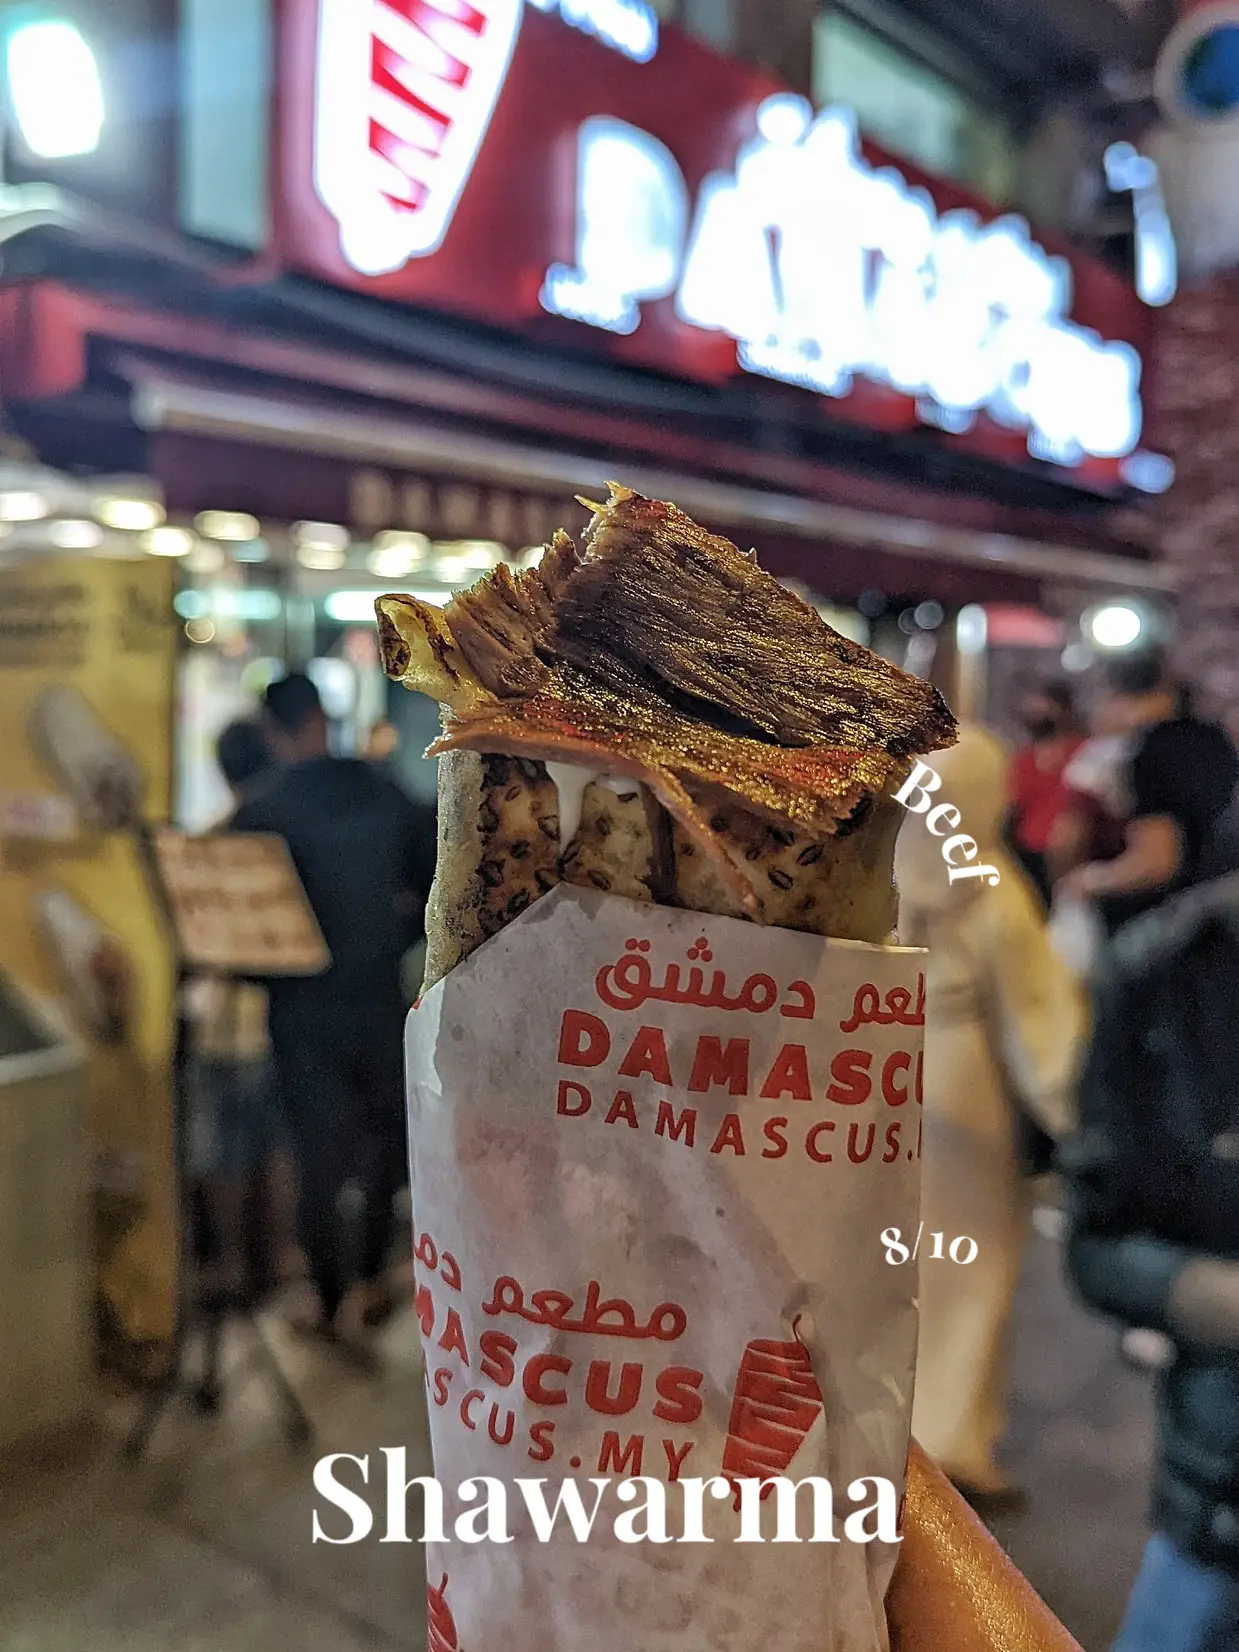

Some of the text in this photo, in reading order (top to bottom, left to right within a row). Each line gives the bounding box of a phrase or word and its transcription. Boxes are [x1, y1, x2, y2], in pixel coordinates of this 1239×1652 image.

[595, 936, 816, 1014] دمشق
[557, 1008, 924, 1107] DAMASC
[557, 1079, 922, 1166] DAMASCUS.
[482, 1275, 687, 1341] مطعم
[425, 1362, 696, 1482] SCUS.MY
